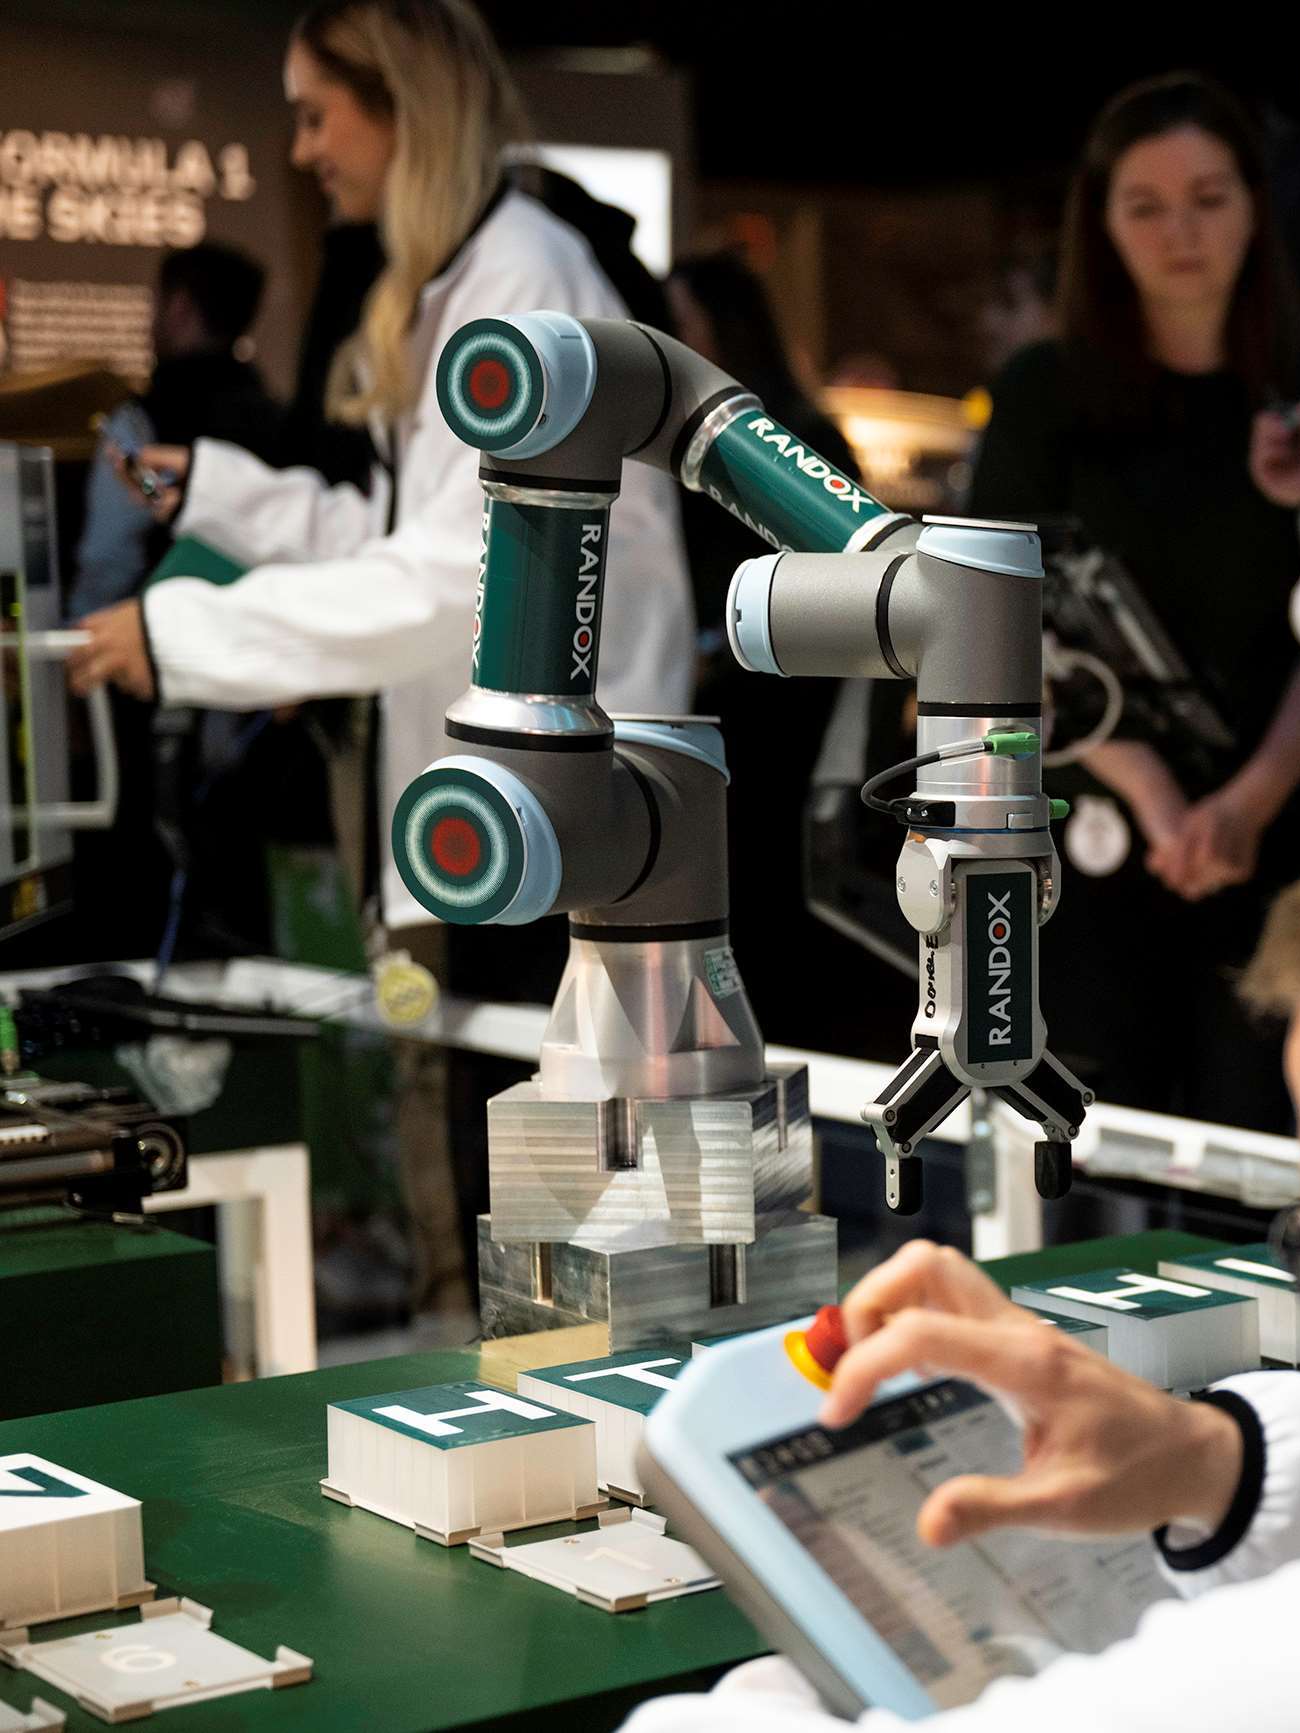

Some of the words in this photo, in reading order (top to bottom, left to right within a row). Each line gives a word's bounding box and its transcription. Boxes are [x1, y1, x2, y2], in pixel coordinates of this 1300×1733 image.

[747, 417, 874, 513] RANDOX
[570, 523, 602, 681] RANDOX
[987, 889, 1012, 1047] RANDOX
[371, 1389, 558, 1437] H
